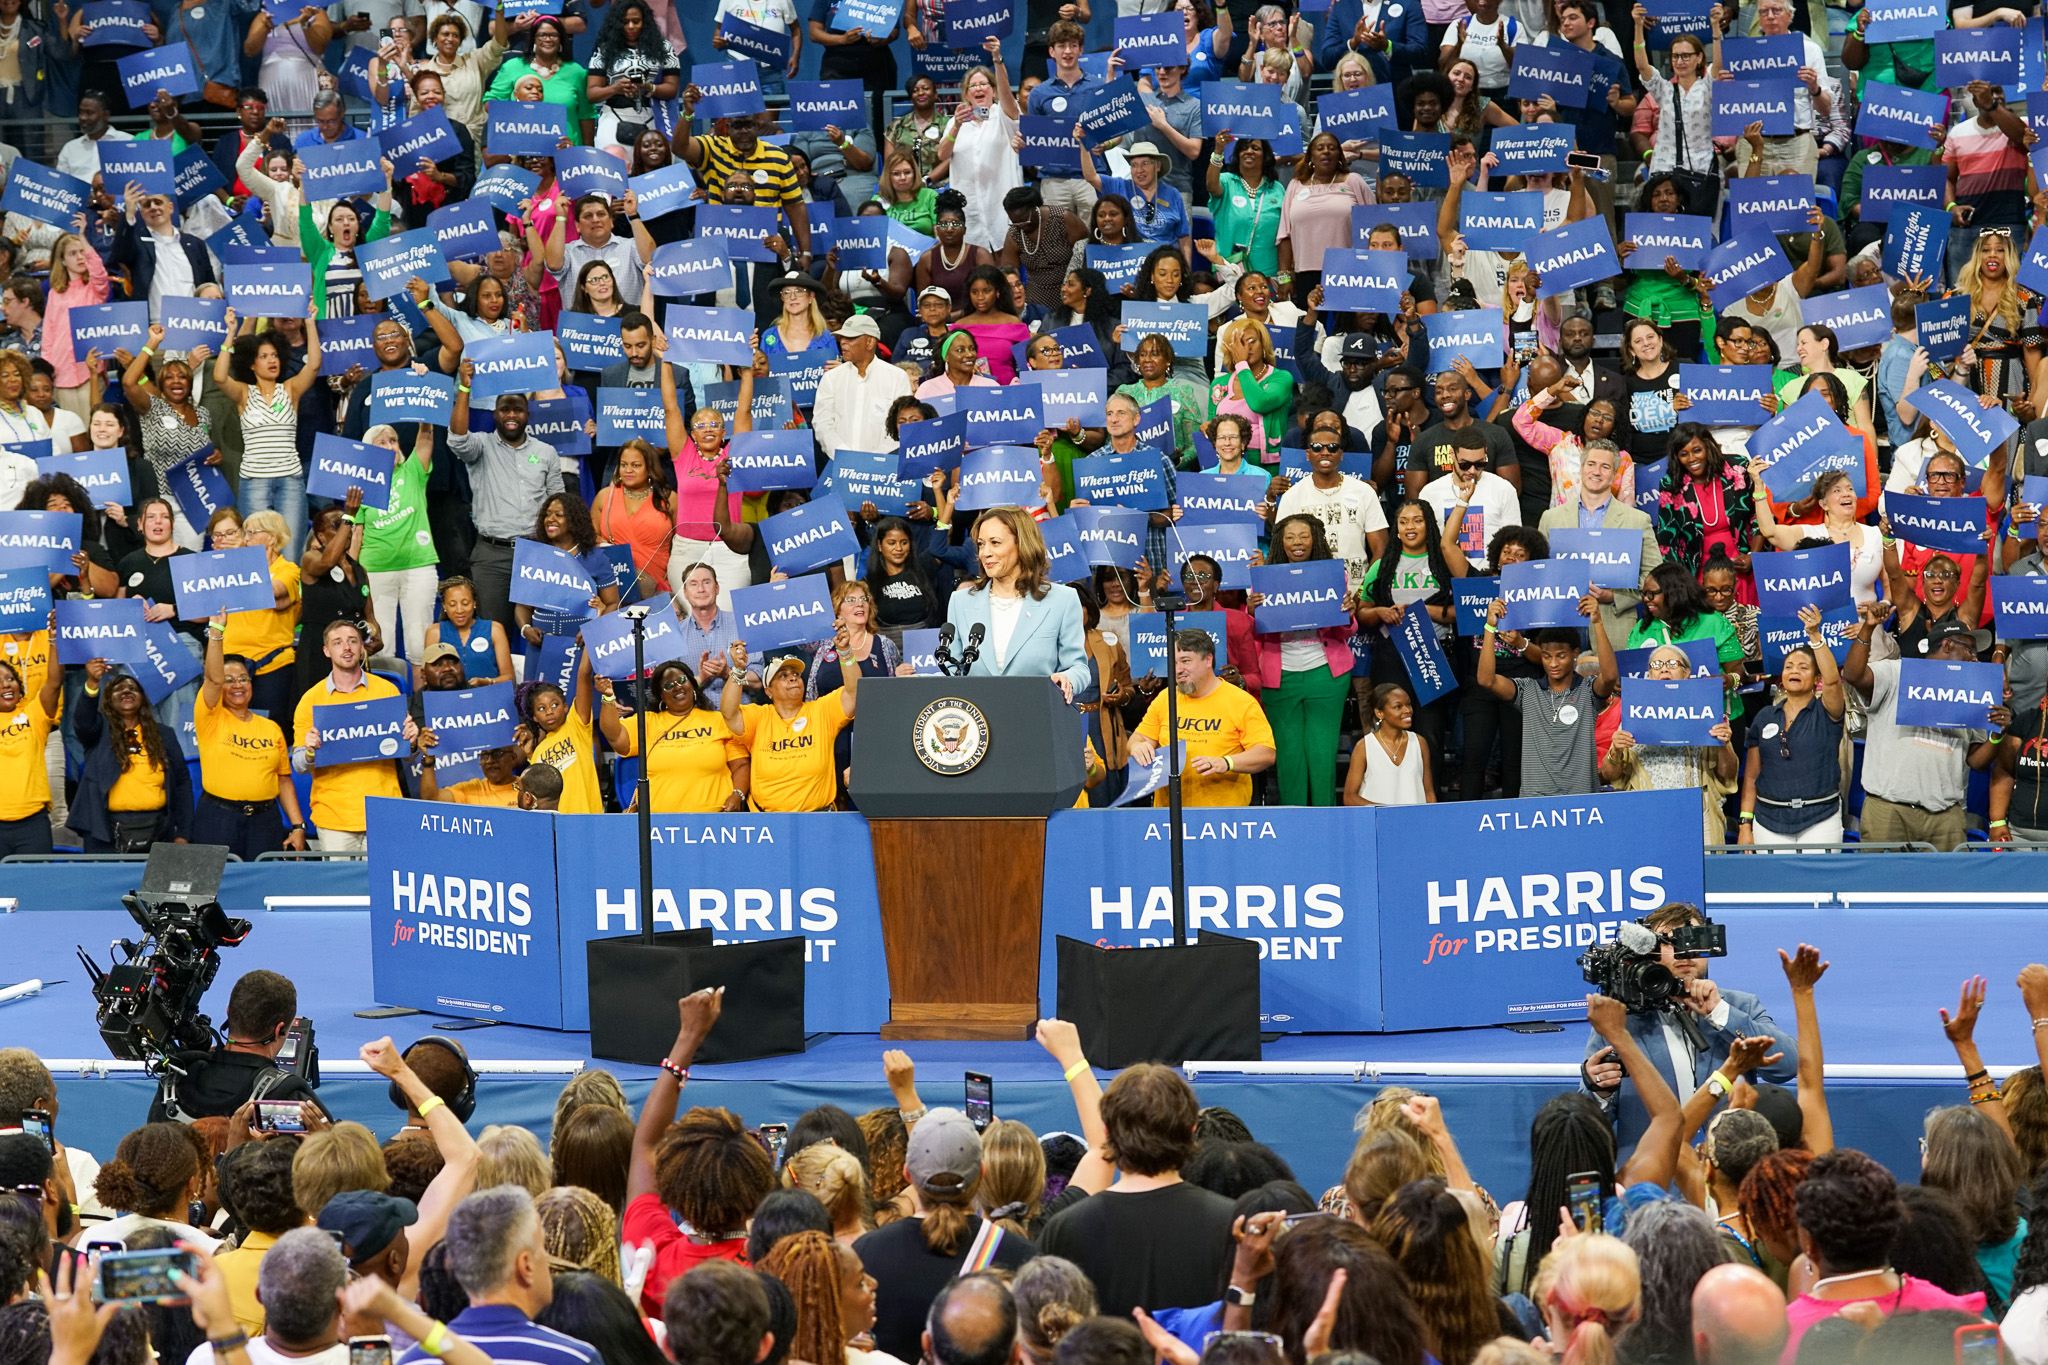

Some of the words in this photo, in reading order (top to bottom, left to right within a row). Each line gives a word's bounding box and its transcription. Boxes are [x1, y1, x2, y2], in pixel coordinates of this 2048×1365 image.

[89, 16, 145, 29] KAMALA
[952, 8, 1010, 30] KAMALA
[1871, 6, 1938, 22] KAMALA
[1662, 24, 1681, 34] WE
[724, 31, 781, 56] KAMALA
[1118, 33, 1179, 49] KAMALA
[1730, 56, 1798, 71] KAMALA
[1942, 51, 2011, 64] KAMALA
[127, 63, 186, 88] KAMALA
[1517, 65, 1583, 85] KAMALA
[699, 81, 757, 96] KAMALA
[797, 100, 858, 112] KAMALA
[1208, 104, 1272, 117] KAMALA
[1719, 102, 1787, 114] KAMALA
[1867, 103, 1934, 125] KAMALA
[1326, 106, 1388, 127] KAMALA
[495, 122, 561, 135] KAMALA
[387, 127, 447, 160] KAMALA
[1496, 140, 1524, 150] When
[1538, 138, 1568, 151] fight,
[1383, 146, 1407, 155] When
[1417, 149, 1445, 162] fight,
[1504, 150, 1525, 160] WE
[1527, 149, 1556, 158] WIN.
[104, 161, 166, 174] KAMALA
[308, 160, 376, 180] KAMALA
[561, 165, 623, 181] KAMALA
[1388, 160, 1402, 169] WE
[1405, 162, 1433, 171] WIN.
[14, 174, 43, 193] When
[42, 186, 57, 197] we
[54, 188, 83, 208] fight,
[1869, 187, 1938, 199] KAMALA
[21, 189, 42, 203] WE
[42, 197, 71, 213] WIN.
[1738, 198, 1810, 214] KAMALA
[1466, 215, 1536, 228] KAMALA
[1905, 211, 1921, 240] fight,
[836, 237, 881, 250] KAMALA
[1633, 234, 1703, 248] KAMALA
[1904, 239, 1911, 249] we
[1915, 224, 1930, 253] WIN.
[365, 257, 394, 272] When
[394, 255, 409, 264] we
[408, 244, 437, 261] fight,
[1535, 242, 1606, 272] KAMALA
[1711, 246, 1776, 284] KAMALA
[1898, 250, 1909, 276] When
[1910, 253, 1923, 274] WE
[379, 267, 401, 280] WE
[401, 258, 431, 274] WIN.
[655, 257, 723, 278] KAMALA
[231, 284, 304, 296] KAMALA
[1325, 274, 1398, 289] KAMALA
[76, 324, 141, 340] KAMALA
[168, 317, 230, 334] KAMAL
[1921, 320, 1940, 332] When
[1942, 321, 1950, 329] we
[1949, 315, 1968, 330] fight,
[672, 327, 746, 343] KAMALA
[1430, 333, 1495, 350] KAMALA
[1929, 333, 1943, 344] WE
[1943, 330, 1961, 342] WIN.
[475, 355, 549, 374] KAMALA
[377, 388, 404, 397] When
[406, 386, 419, 396] we
[418, 387, 448, 401] fight,
[1687, 388, 1761, 400] KAMALA
[385, 398, 406, 407] WE
[408, 399, 438, 408] WIN.
[967, 407, 1035, 423] KAMALA
[1928, 388, 1993, 444] KAMALA
[906, 435, 960, 458] KAMALA
[1763, 416, 1832, 466] KAMALA
[732, 455, 806, 468] KAMALA
[319, 458, 385, 485] KAMALA
[963, 470, 1036, 486] KAMALA
[1080, 476, 1110, 487] When
[1112, 474, 1127, 484] we
[1126, 469, 1158, 485] fight,
[185, 460, 217, 516] KAMALA
[1091, 488, 1114, 499] WE
[1116, 484, 1148, 496] WIN.
[1184, 496, 1256, 511] KAMALA
[372, 505, 414, 529] Women
[1467, 514, 1483, 523] THAT
[1894, 513, 1976, 532] KAMALA
[0, 534, 72, 549] KAMALA
[772, 520, 843, 555] KAMALA
[183, 572, 262, 593] KAMALA
[520, 565, 592, 592] KAMALA
[1764, 570, 1843, 592] KAMALA
[1262, 588, 1338, 607] KAMALA
[1505, 586, 1580, 602] KAMALA
[744, 601, 824, 626] KAMALA
[61, 625, 136, 639] KAMALA
[1409, 612, 1423, 643] When
[1404, 626, 1418, 650] WE
[1414, 650, 1429, 683] WIN.
[1421, 643, 1430, 659] we
[1425, 659, 1442, 690] fight,
[1908, 686, 1994, 704] KAMALA
[949, 700, 962, 708] THE
[1630, 705, 1714, 719] KAMALA
[431, 709, 510, 729] KAMALA
[915, 705, 935, 750] PRESIDENT
[966, 704, 987, 736] UNITED
[1177, 717, 1221, 732] UFCW
[322, 721, 400, 741] KAMALA
[665, 727, 712, 741] UFCW
[233, 734, 274, 750] UFCW
[772, 735, 813, 752] UFCW
[921, 753, 939, 770] VICE
[964, 740, 987, 769] STATES
[421, 814, 494, 837] ATLANTA
[1479, 806, 1604, 832] ATLANTA
[650, 826, 774, 844] ATLANTA
[392, 870, 532, 927] HARRIS
[1426, 864, 1667, 925] HARRIS
[596, 888, 839, 931] HARRIS
[1090, 883, 1344, 929] HARRIS
[391, 919, 415, 947] for
[418, 921, 531, 957] PRESIDENT
[1422, 931, 1468, 965] for
[1474, 919, 1628, 956] PRESIDE
[1522, 1005, 1530, 1013] for
